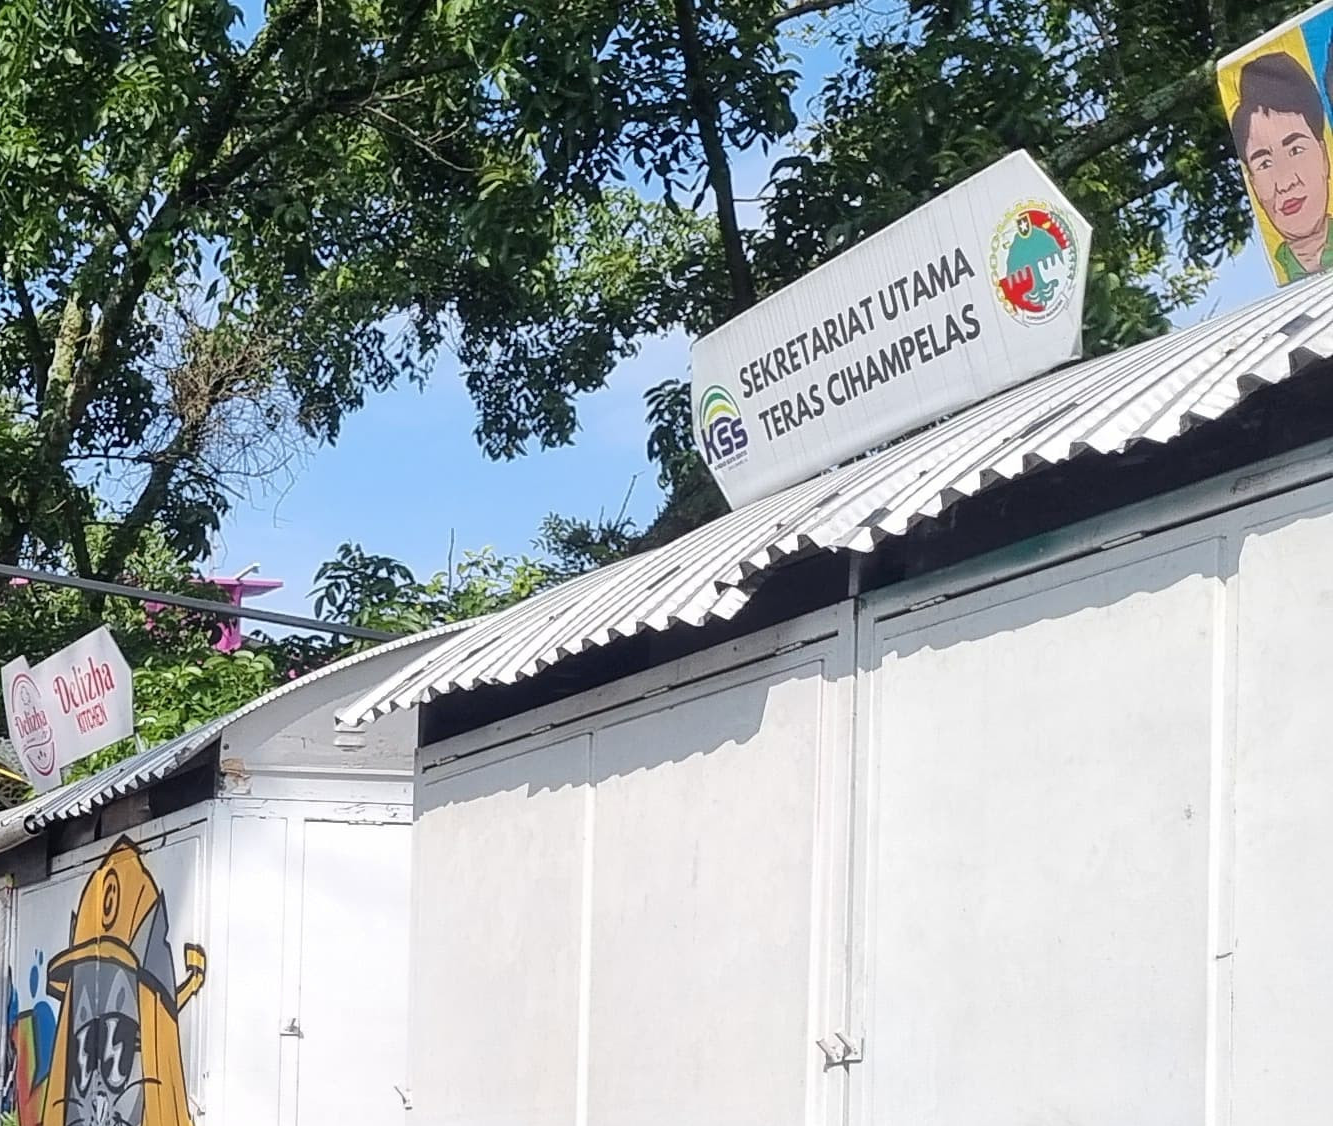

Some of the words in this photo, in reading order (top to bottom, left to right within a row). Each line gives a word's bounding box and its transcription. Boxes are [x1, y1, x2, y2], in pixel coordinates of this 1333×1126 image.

[739, 296, 875, 398] SEKRETARIAT
[878, 247, 975, 321] UTAMA
[758, 384, 825, 441] TERAS
[827, 304, 981, 406] CIHAMPELAS
[700, 416, 749, 465] KSS
[54, 656, 115, 715] Delizha
